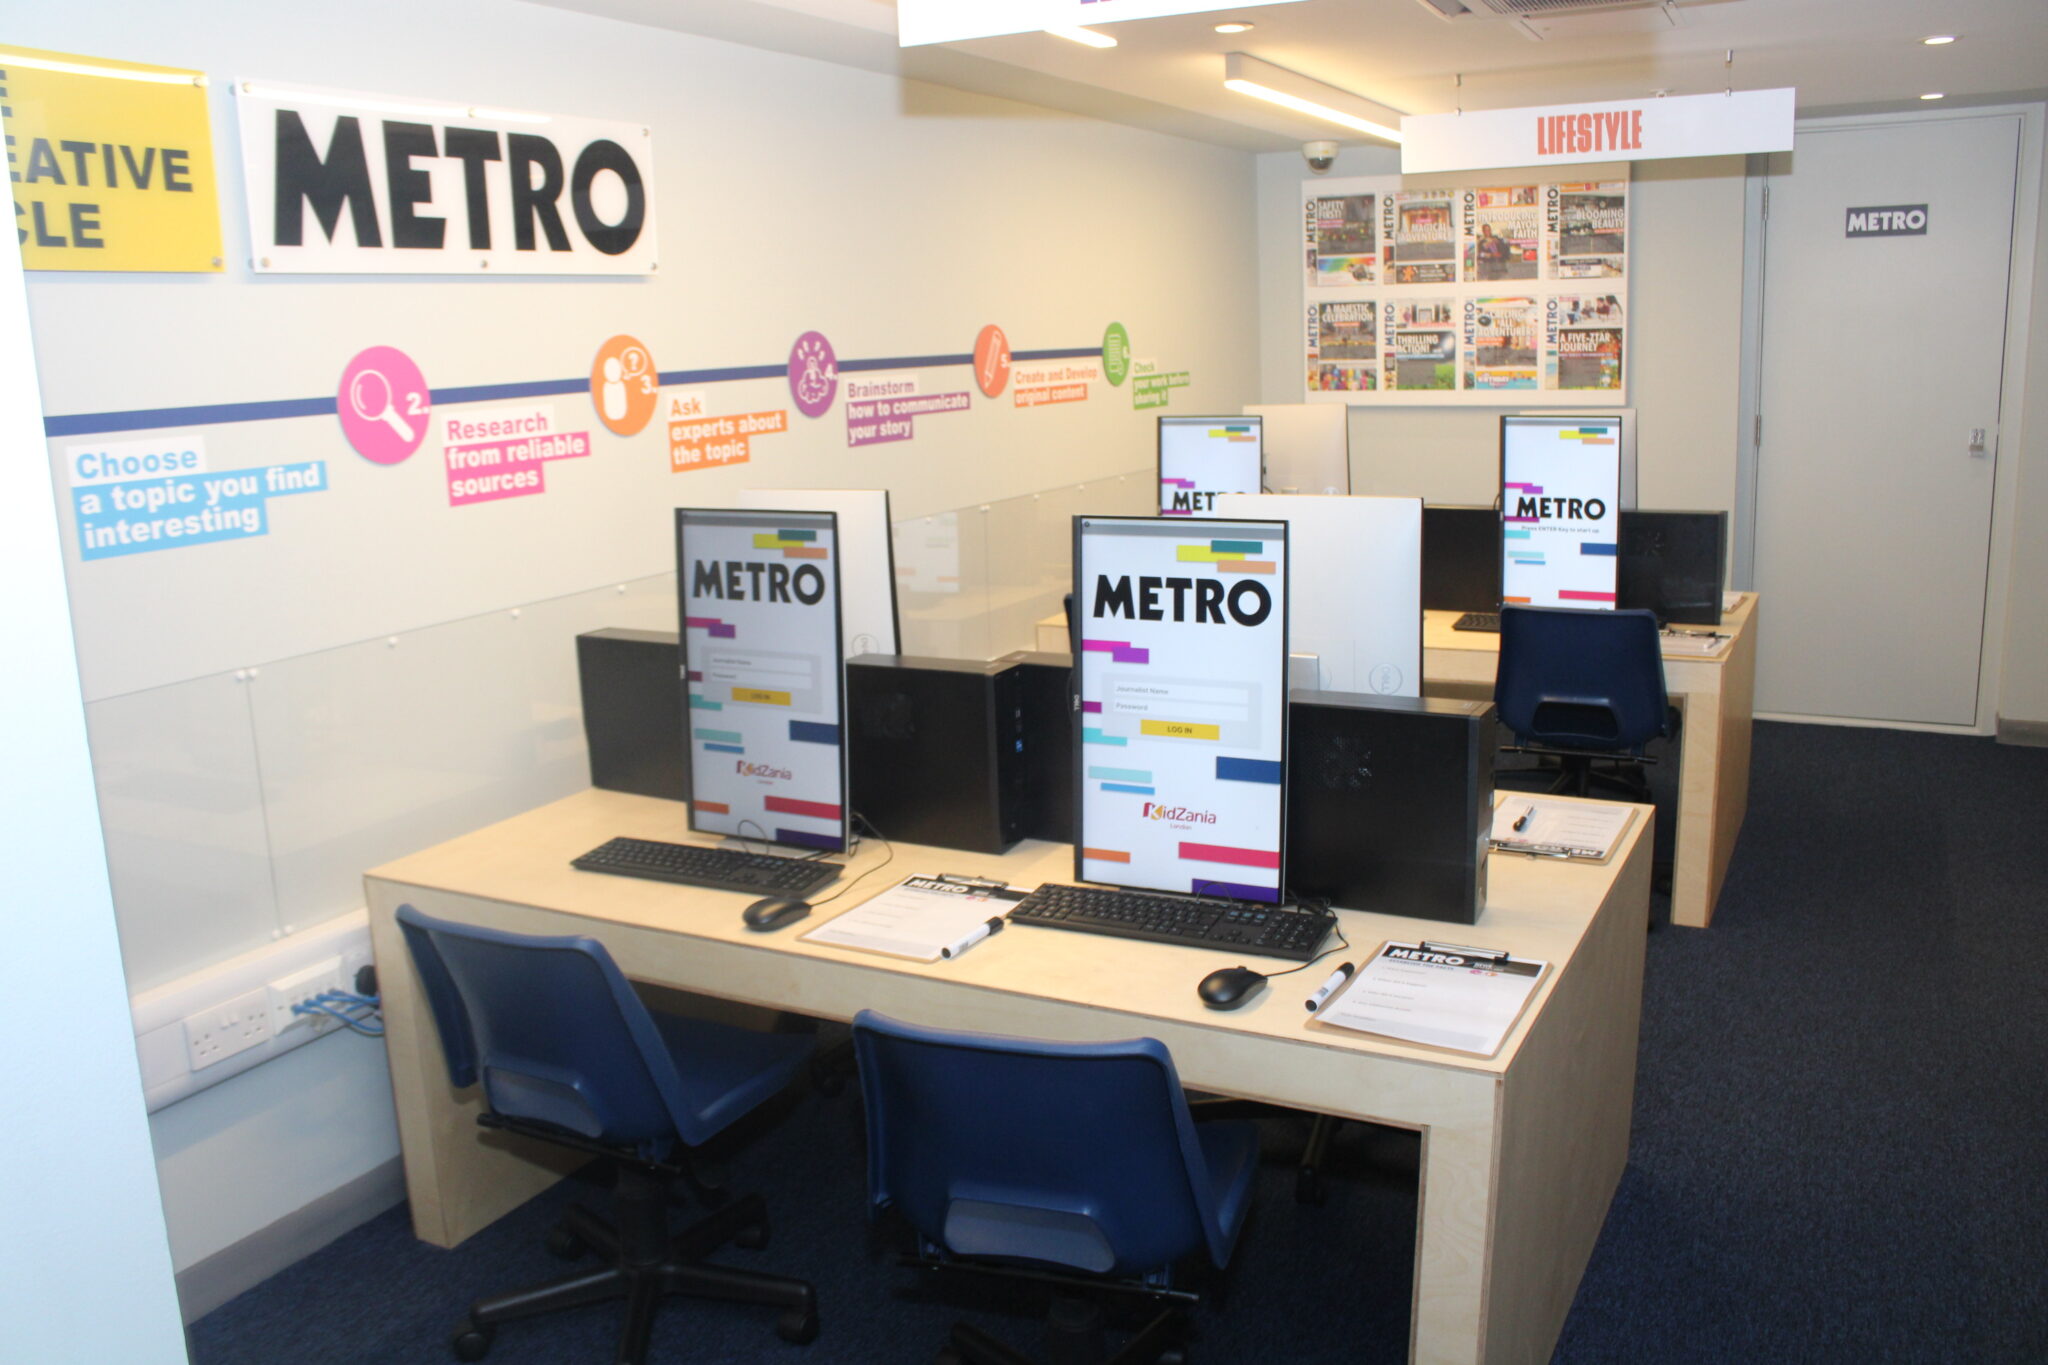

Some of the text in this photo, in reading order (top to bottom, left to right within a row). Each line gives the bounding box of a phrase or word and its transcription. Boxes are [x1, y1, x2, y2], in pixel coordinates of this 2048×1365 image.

[1537, 110, 1642, 155] LIFESTYLE
[273, 108, 645, 256] METRO
[1847, 210, 1926, 232] METRO
[1016, 370, 1046, 385] Create
[1049, 368, 1064, 382] and
[848, 380, 914, 399] Brainstorm
[671, 397, 702, 417] Ask
[848, 394, 968, 419] how to communicate
[447, 412, 548, 441] Research
[671, 412, 782, 443] experts about
[849, 420, 911, 444] your story
[76, 450, 198, 479] Choose
[448, 434, 585, 470] from reliable
[673, 440, 746, 466] the topic
[80, 463, 320, 515] a topic you find
[451, 470, 539, 498] sources
[1516, 497, 1606, 520] METRO
[84, 506, 260, 550] interesting
[692, 560, 825, 605] METRO
[1093, 574, 1272, 627] METRO
[1116, 686, 1168, 695] Journalist Name
[1116, 702, 1148, 711] Password
[1168, 726, 1183, 734] LOG
[1142, 802, 1217, 824] KidZania
[908, 879, 969, 893] METRO
[1389, 949, 1464, 965] METRO
